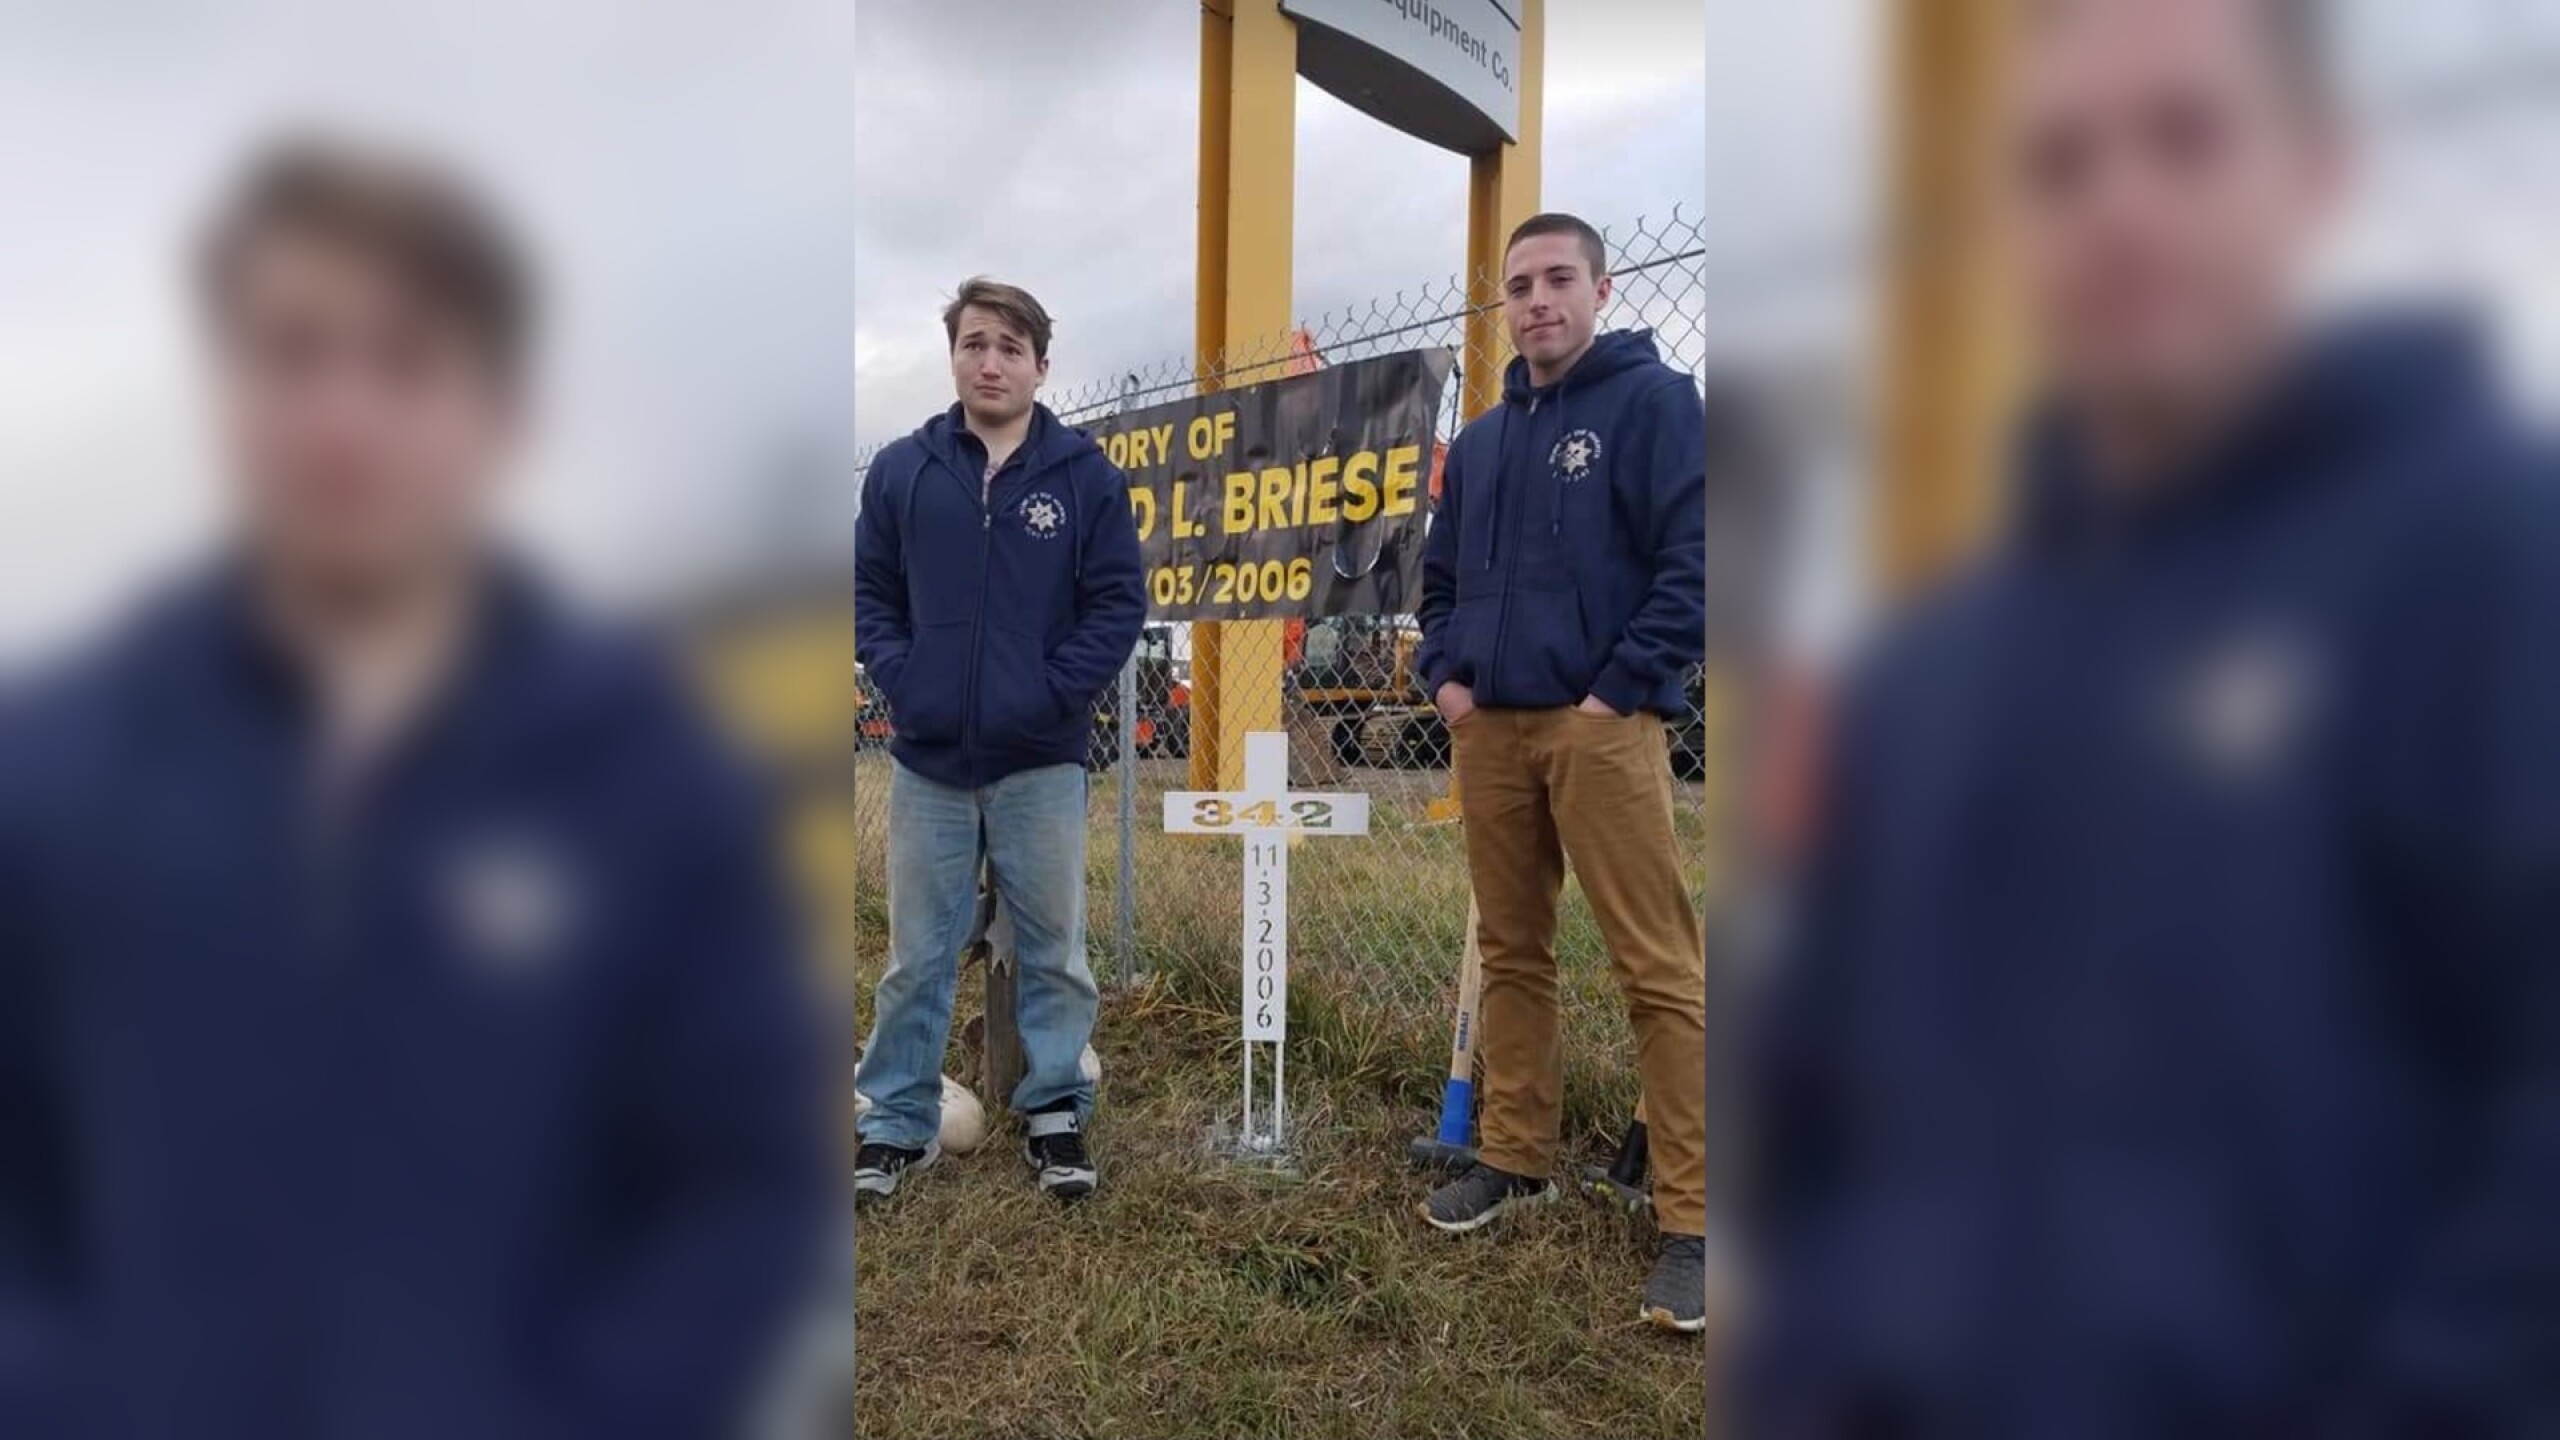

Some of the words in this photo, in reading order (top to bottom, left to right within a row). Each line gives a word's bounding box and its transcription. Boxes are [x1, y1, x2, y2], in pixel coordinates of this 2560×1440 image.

[1384, 0, 1487, 68] quipment
[1492, 51, 1513, 93] Co.
[1188, 411, 1236, 460] OF
[1172, 480, 1206, 539] L.
[1223, 445, 1420, 534] BRIESE
[1192, 800, 1332, 828] 342
